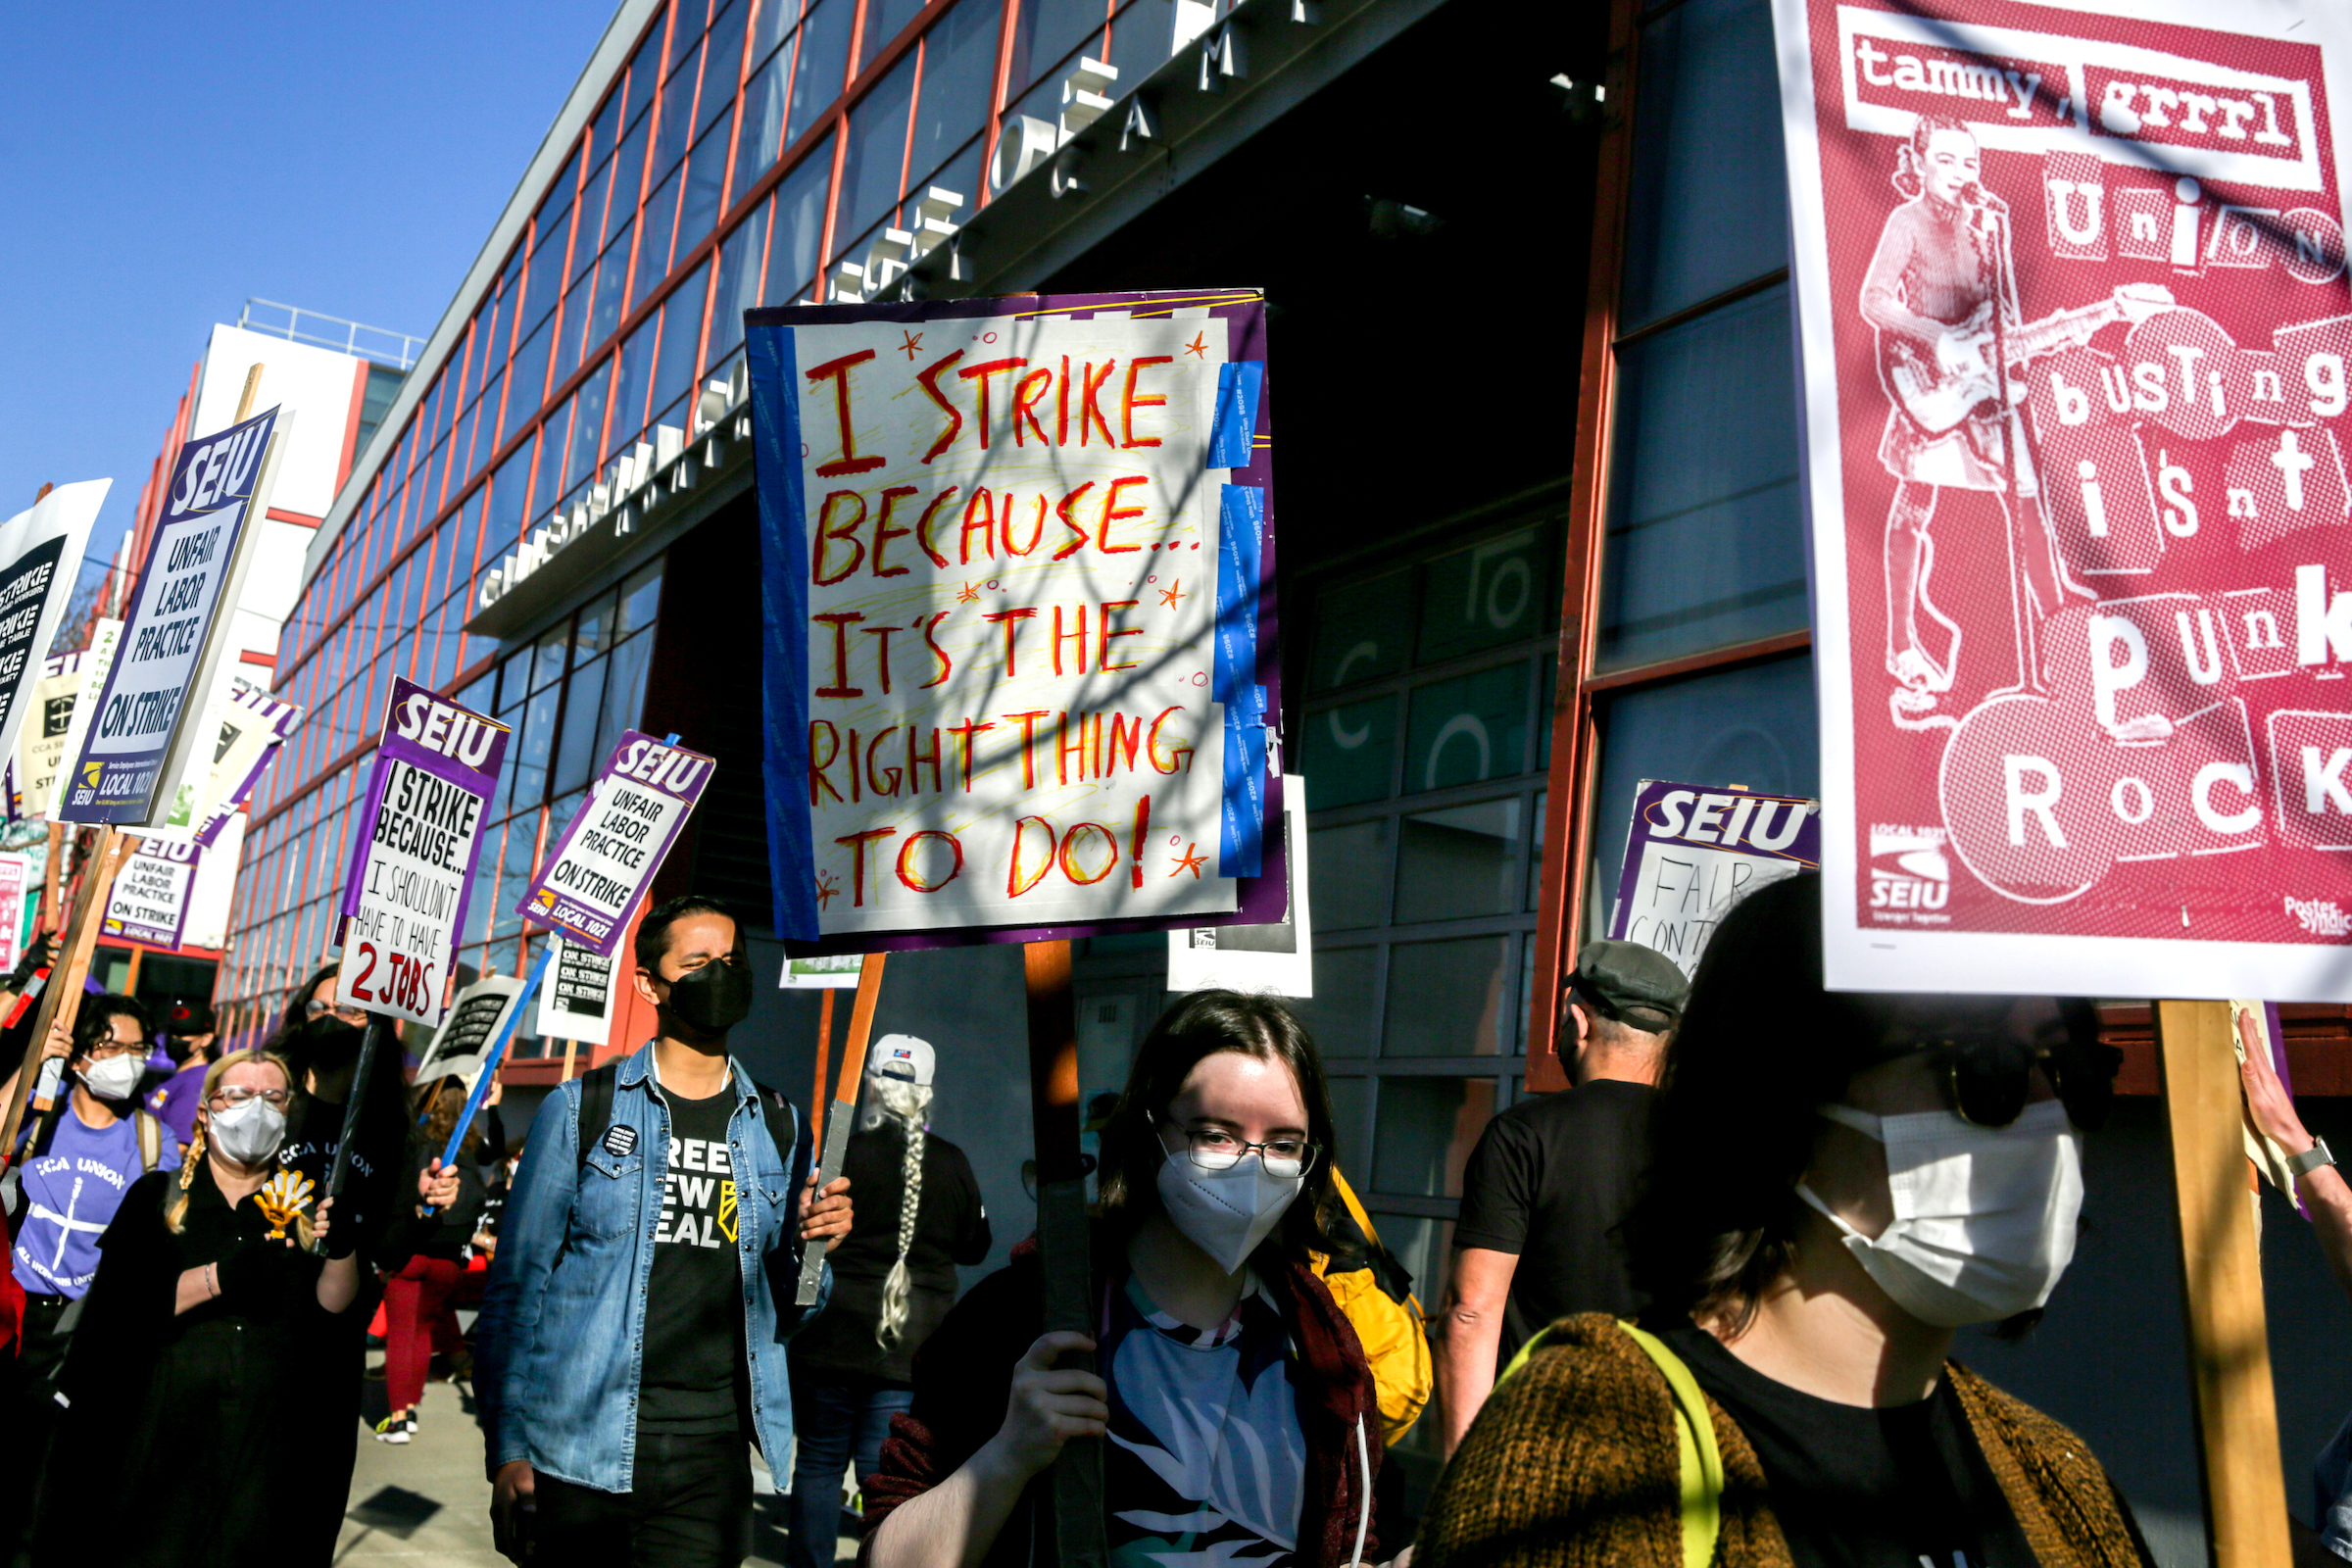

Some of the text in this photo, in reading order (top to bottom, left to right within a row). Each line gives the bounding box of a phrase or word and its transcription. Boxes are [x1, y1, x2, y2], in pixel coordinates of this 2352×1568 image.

[2100, 80, 2292, 147] grrrl
[806, 348, 1174, 478] I STRIKE
[171, 418, 270, 515] SEIU
[167, 525, 221, 572] UNFAIR
[154, 571, 207, 616] LABOR
[131, 615, 200, 662] PRACTICE
[812, 600, 1145, 698] IT'S THE
[101, 693, 135, 739] ON
[125, 686, 182, 737] STRIKE
[1254, 685, 1264, 709] #209
[397, 692, 498, 767] SEIU
[614, 739, 706, 793] SEIU
[808, 705, 1195, 808] RIGHT THING
[72, 789, 95, 806] SEIU
[99, 771, 155, 796] LOCAL 1021
[382, 758, 479, 839] I STRIKE
[612, 787, 663, 823] UNFAIR
[1649, 790, 1808, 851] SEIU
[600, 809, 650, 844] LABOR
[138, 837, 196, 862] EIU
[580, 830, 645, 869] PRACTICE
[835, 794, 1152, 907] TO DO!
[132, 872, 172, 889] LABOR
[133, 860, 175, 878] UNFAIR
[368, 858, 385, 895] I
[554, 858, 632, 909] ON STRIKE
[1653, 857, 1753, 913] FAIR
[122, 883, 175, 904] PRACTICE
[527, 902, 550, 917] SEIU
[1870, 881, 1949, 909] SEIU
[2284, 896, 2337, 916] Poster
[113, 902, 175, 926] ON STRIKE
[354, 904, 442, 960] HAVE TO HAVE
[552, 905, 586, 928] LOCAL
[584, 920, 611, 939] 1021
[1195, 939, 1215, 948] SEIU
[1631, 916, 1716, 956] CONT
[351, 942, 434, 1017] 2 JOBS
[77, 1157, 125, 1191] UNION
[278, 1142, 373, 1178] CCA UON
[668, 1137, 731, 1174] REE
[663, 1173, 715, 1209] EW
[655, 1211, 721, 1250] EAL
[16, 1246, 30, 1264] ALL
